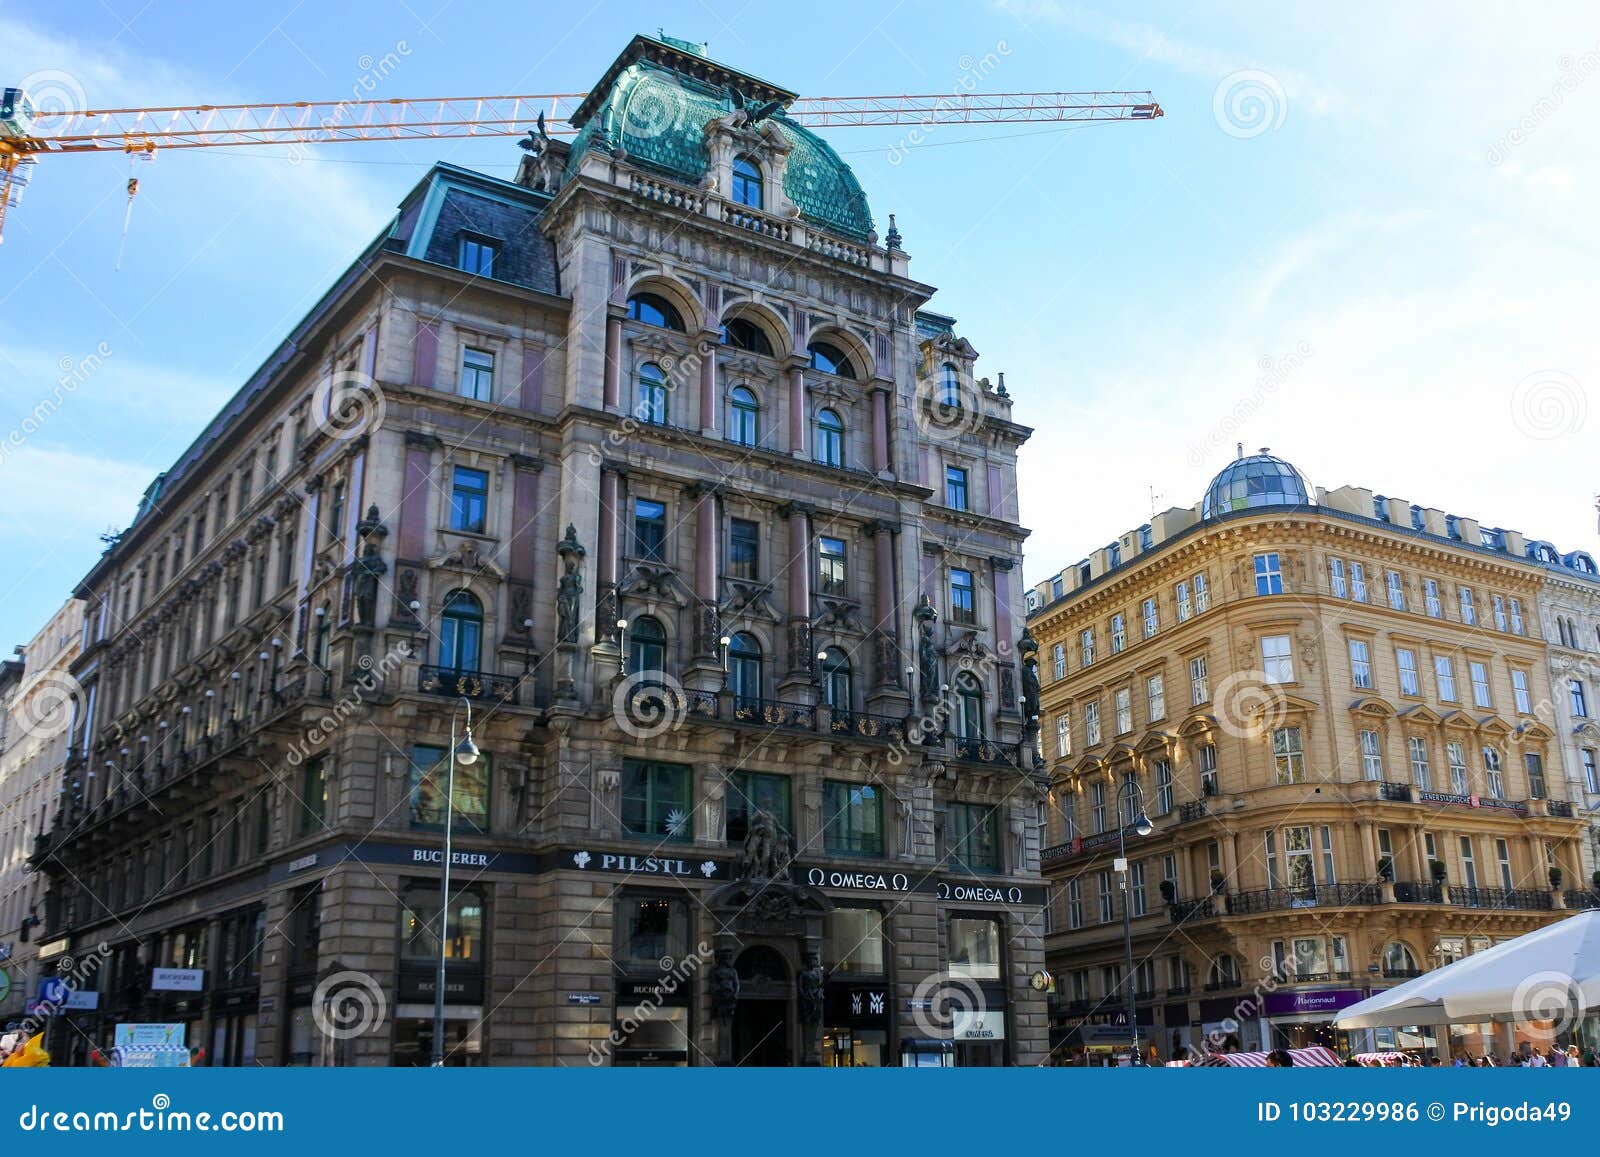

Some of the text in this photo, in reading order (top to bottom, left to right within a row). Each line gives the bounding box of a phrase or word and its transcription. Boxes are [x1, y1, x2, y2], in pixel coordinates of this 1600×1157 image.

[413, 849, 488, 866] BUCERER
[602, 854, 691, 875] PILSTL
[830, 872, 887, 889] OMEGA
[955, 886, 1004, 902] OMEGA
